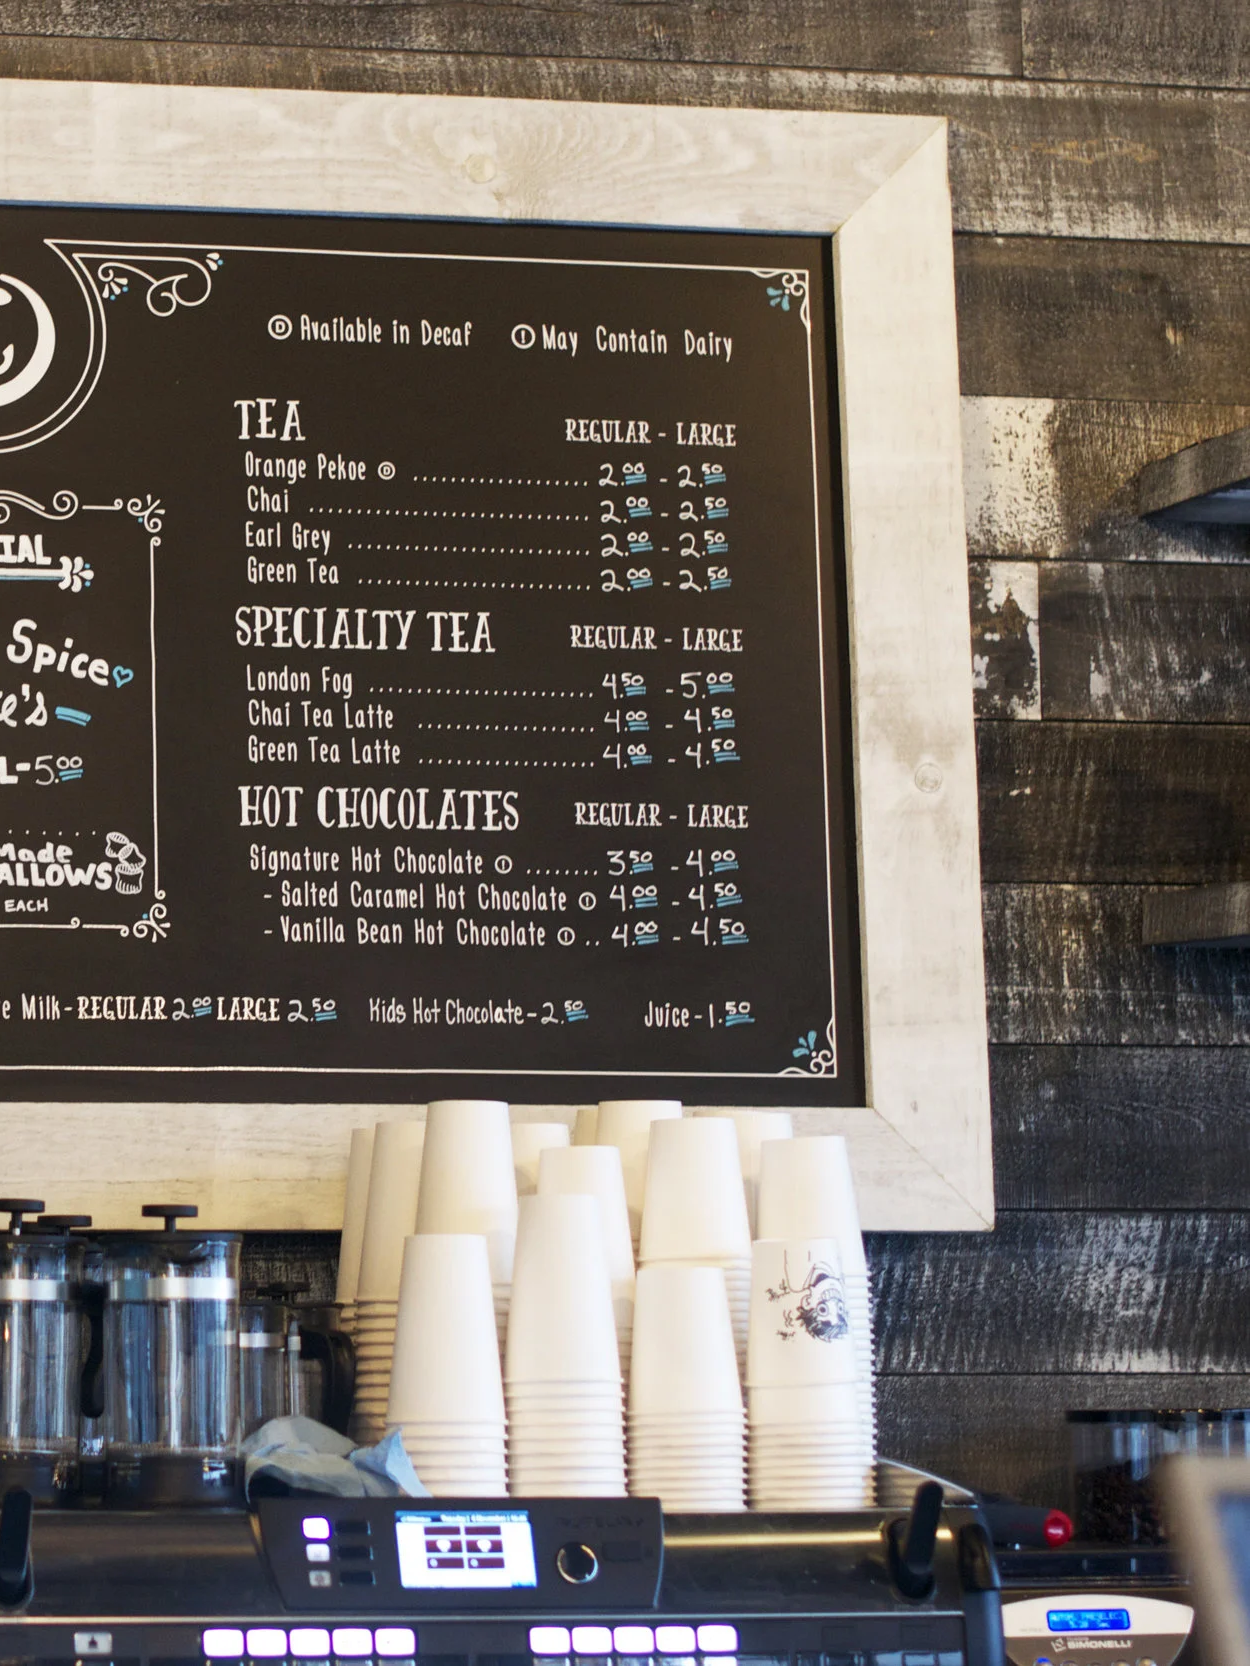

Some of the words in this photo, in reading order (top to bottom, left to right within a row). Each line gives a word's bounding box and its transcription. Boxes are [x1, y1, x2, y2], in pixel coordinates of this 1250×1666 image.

[300, 313, 382, 344] Available
[392, 319, 410, 345] in
[420, 319, 473, 347] Decaf
[541, 323, 578, 357] May
[595, 325, 668, 354] Contain
[684, 328, 733, 363] Dairy
[233, 397, 306, 442] TEA
[564, 418, 652, 444] REGULAR
[676, 421, 737, 448] LARGE
[244, 450, 307, 485] Orange
[317, 452, 367, 481] Pekoe
[598, 462, 647, 487] 2.00
[677, 462, 723, 488] 2.50
[247, 484, 289, 514] Chai
[600, 496, 649, 524] 2.00
[678, 496, 727, 522] 2.50
[245, 520, 281, 548] Earl
[292, 521, 331, 556] Grey
[600, 531, 653, 558] 2.00
[678, 529, 726, 559] 2.50
[247, 555, 297, 585] Green
[306, 557, 340, 585] Tea
[600, 567, 652, 593] 2.00
[678, 566, 729, 593] 2.50
[235, 605, 417, 651] SPECIALTY
[426, 611, 496, 653] TEA
[569, 624, 658, 650] REGULAR
[682, 627, 743, 653] LARGE
[6, 618, 110, 687] Spice
[246, 663, 311, 692] London
[321, 666, 353, 700] Fog
[601, 672, 645, 700] 4.50
[680, 671, 734, 699] 5.00
[248, 698, 291, 727] Chai
[300, 700, 334, 728] Tea
[344, 701, 394, 729] Latte
[603, 709, 648, 734] 4.00
[683, 706, 735, 734] 4.50
[34, 754, 83, 786] 5.00
[248, 734, 298, 764] Green
[307, 735, 341, 763] Tea
[351, 736, 401, 765] Latte
[602, 743, 649, 770] 4.00
[684, 738, 737, 769] 4.50
[237, 784, 304, 828] HOT
[317, 785, 520, 832] CHOCOLATES
[574, 801, 663, 827] REGULAR
[687, 803, 749, 829] LARGE
[249, 843, 340, 877] Signature
[351, 845, 382, 873] Hot
[393, 845, 483, 875] Chocolate
[606, 849, 653, 876] 3.50
[685, 848, 736, 878] 4.00
[4, 897, 49, 913] EACH
[281, 879, 339, 908] Salted
[350, 880, 424, 909] Caramel
[435, 882, 466, 910] Hot
[477, 882, 567, 912] Chocolate
[609, 884, 658, 912] 4.00
[688, 882, 738, 911] 4.50
[280, 915, 346, 944] Vanilla
[356, 917, 403, 945] Bean
[414, 917, 444, 946] Hot
[456, 917, 546, 947] Chocolate
[611, 920, 659, 948] 4.00
[690, 916, 745, 946] 4.50
[171, 996, 212, 1021] 2.00
[216, 996, 281, 1022] LARGE
[287, 997, 337, 1023] 2.50
[369, 997, 407, 1024] Kids
[412, 996, 441, 1024] Hot
